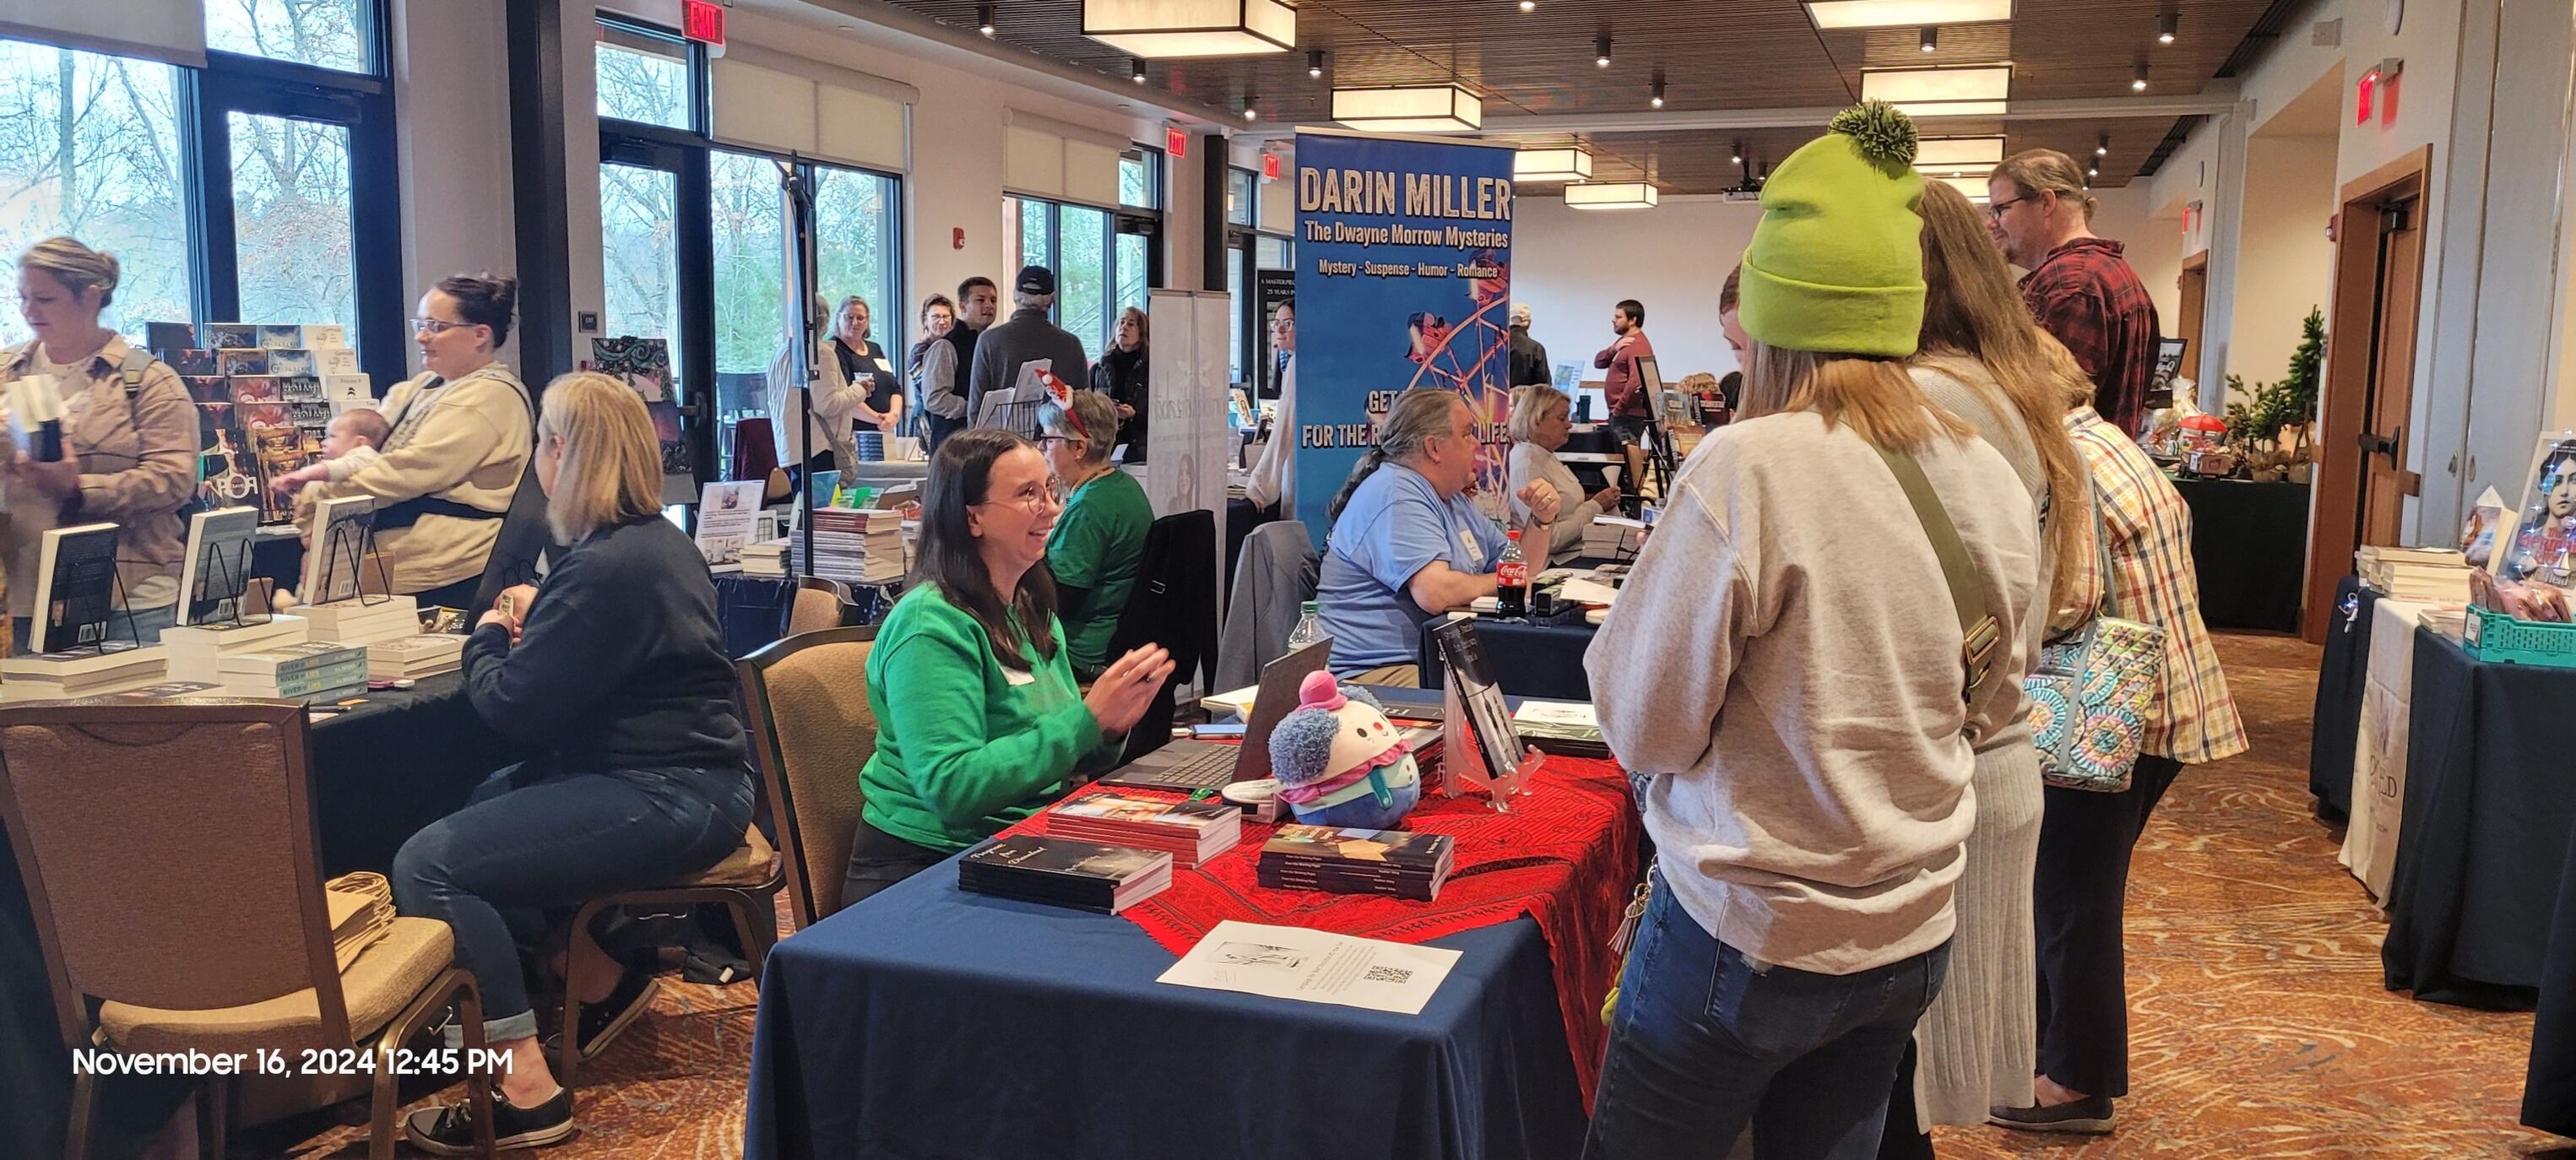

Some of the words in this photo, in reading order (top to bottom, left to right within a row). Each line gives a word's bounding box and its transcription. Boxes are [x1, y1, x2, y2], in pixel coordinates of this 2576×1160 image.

[691, 2, 716, 40] EXIT
[1300, 167, 1396, 214] DARIN
[1405, 172, 1511, 221] MILLER
[1304, 220, 1331, 242] The
[1335, 222, 1388, 247] Dwayne
[1391, 225, 1442, 246] Morrow
[1445, 226, 1509, 251] Mysteries
[1319, 258, 1357, 277] Mystery
[1364, 260, 1410, 279] Suspense
[1418, 263, 1449, 277] Humor
[1457, 263, 1498, 279] Romance
[1369, 390, 1397, 412] GET
[1302, 425, 1334, 447] FOR
[1337, 424, 1368, 447] THE
[1478, 422, 1507, 442] LIFE
[283, 686, 302, 696] RIVER
